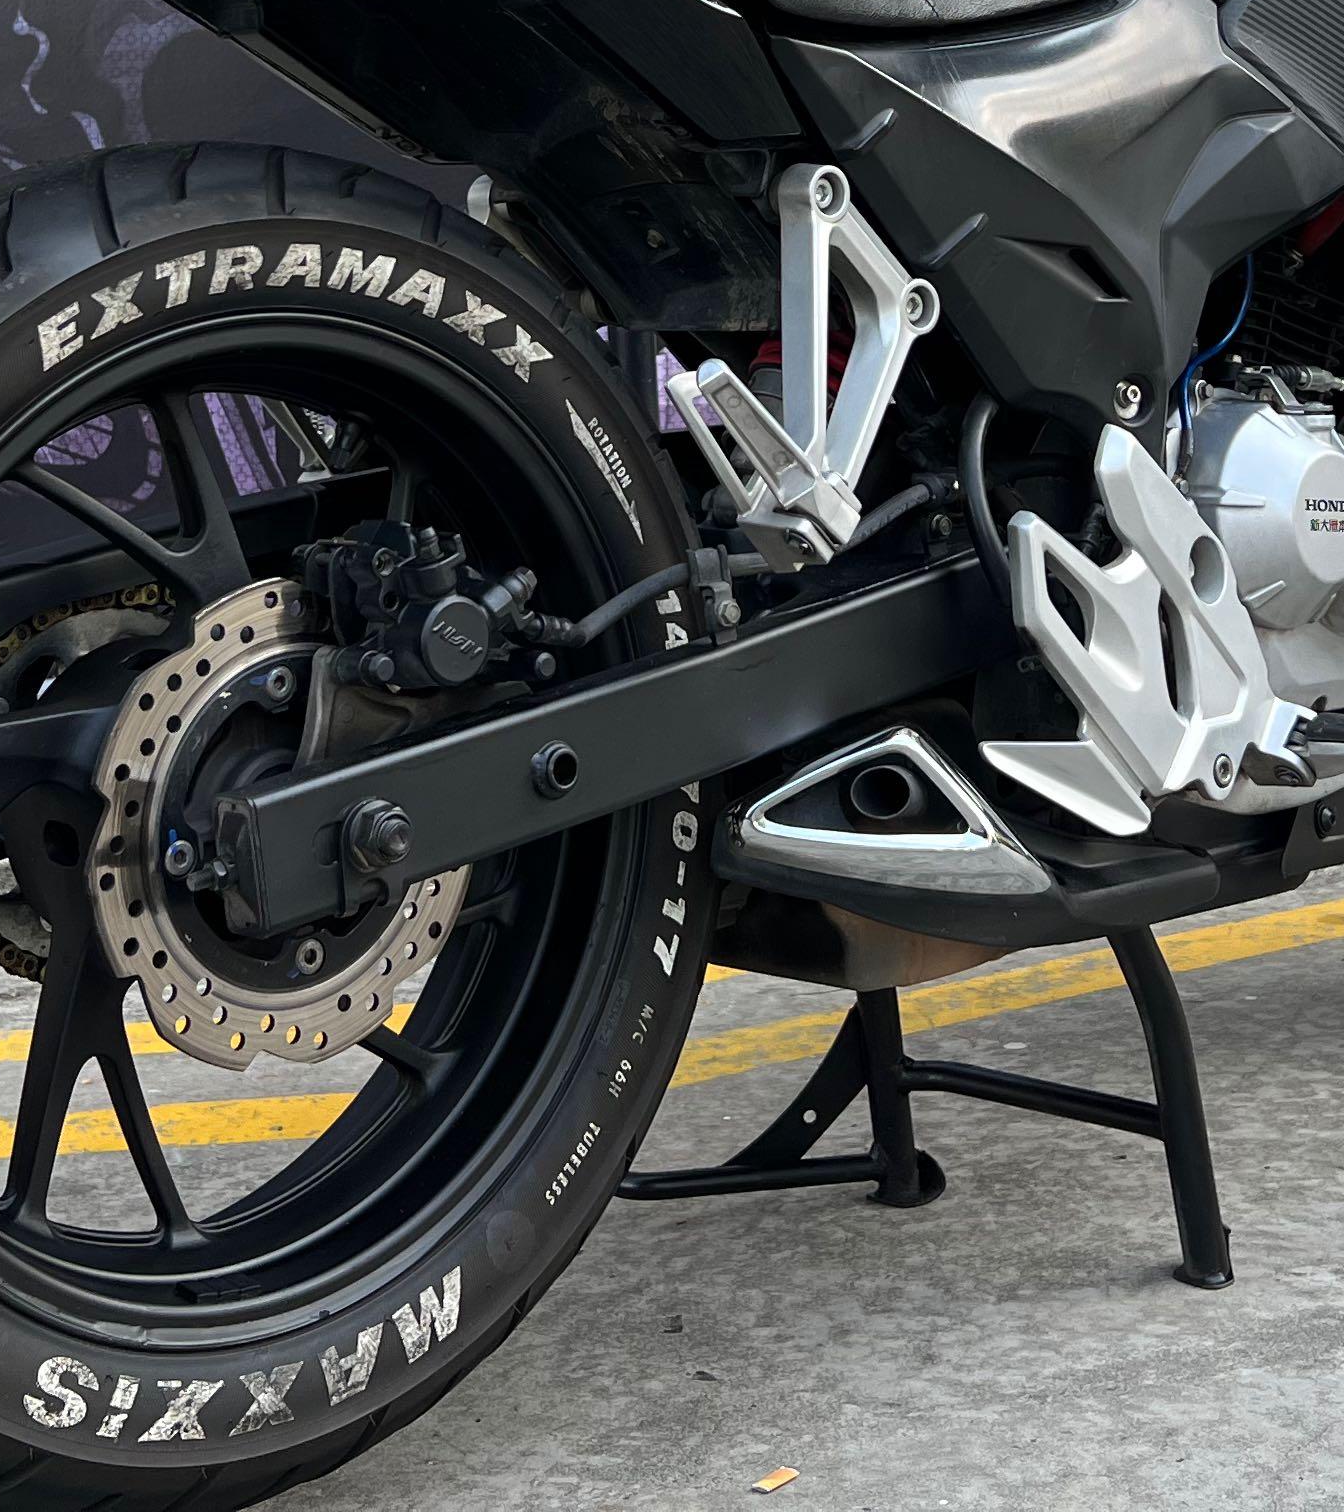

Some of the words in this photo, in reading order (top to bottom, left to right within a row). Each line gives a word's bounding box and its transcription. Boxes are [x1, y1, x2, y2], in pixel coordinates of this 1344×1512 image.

[35, 243, 554, 383] EXTRAMAXX
[588, 416, 632, 489] ROTATION
[632, 1003, 655, 1045] M/C
[608, 1059, 632, 1098] 66H
[545, 1122, 601, 1206] TUBELESS
[23, 1265, 461, 1444] MAXXIS
